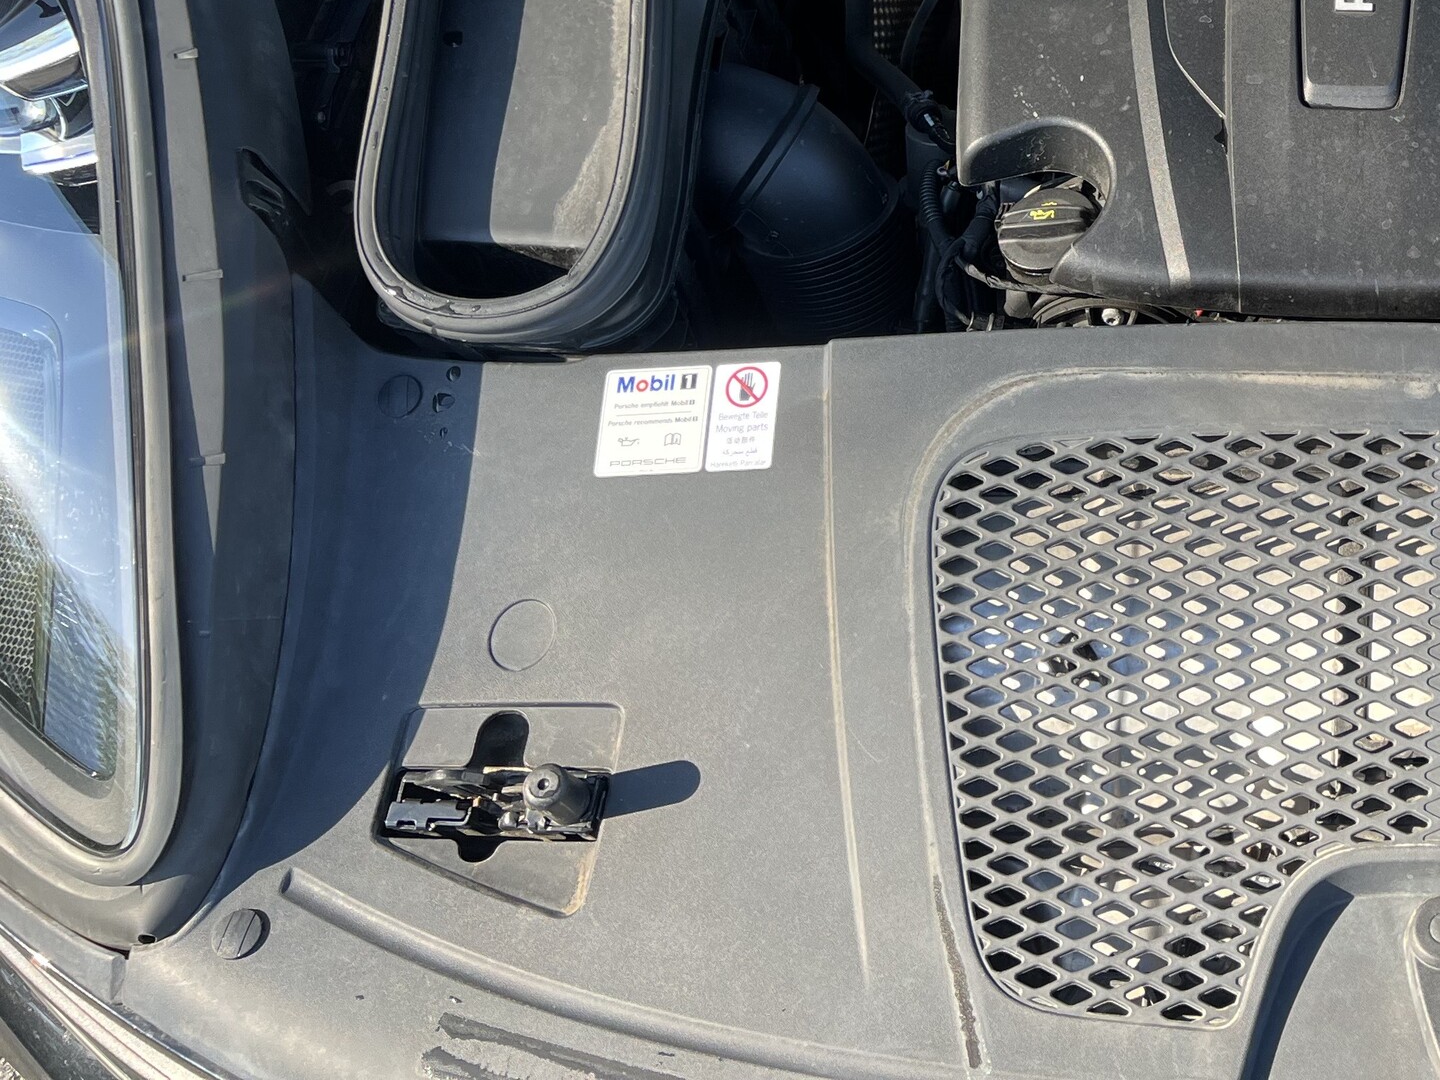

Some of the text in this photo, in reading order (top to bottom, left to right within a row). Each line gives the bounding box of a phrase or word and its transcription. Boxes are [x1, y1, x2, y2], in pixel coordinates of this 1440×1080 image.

[617, 373, 698, 393] Mobil 1
[634, 418, 673, 426] recommends
[716, 423, 769, 433] Moving parts
[610, 457, 687, 467] PORSCHE
